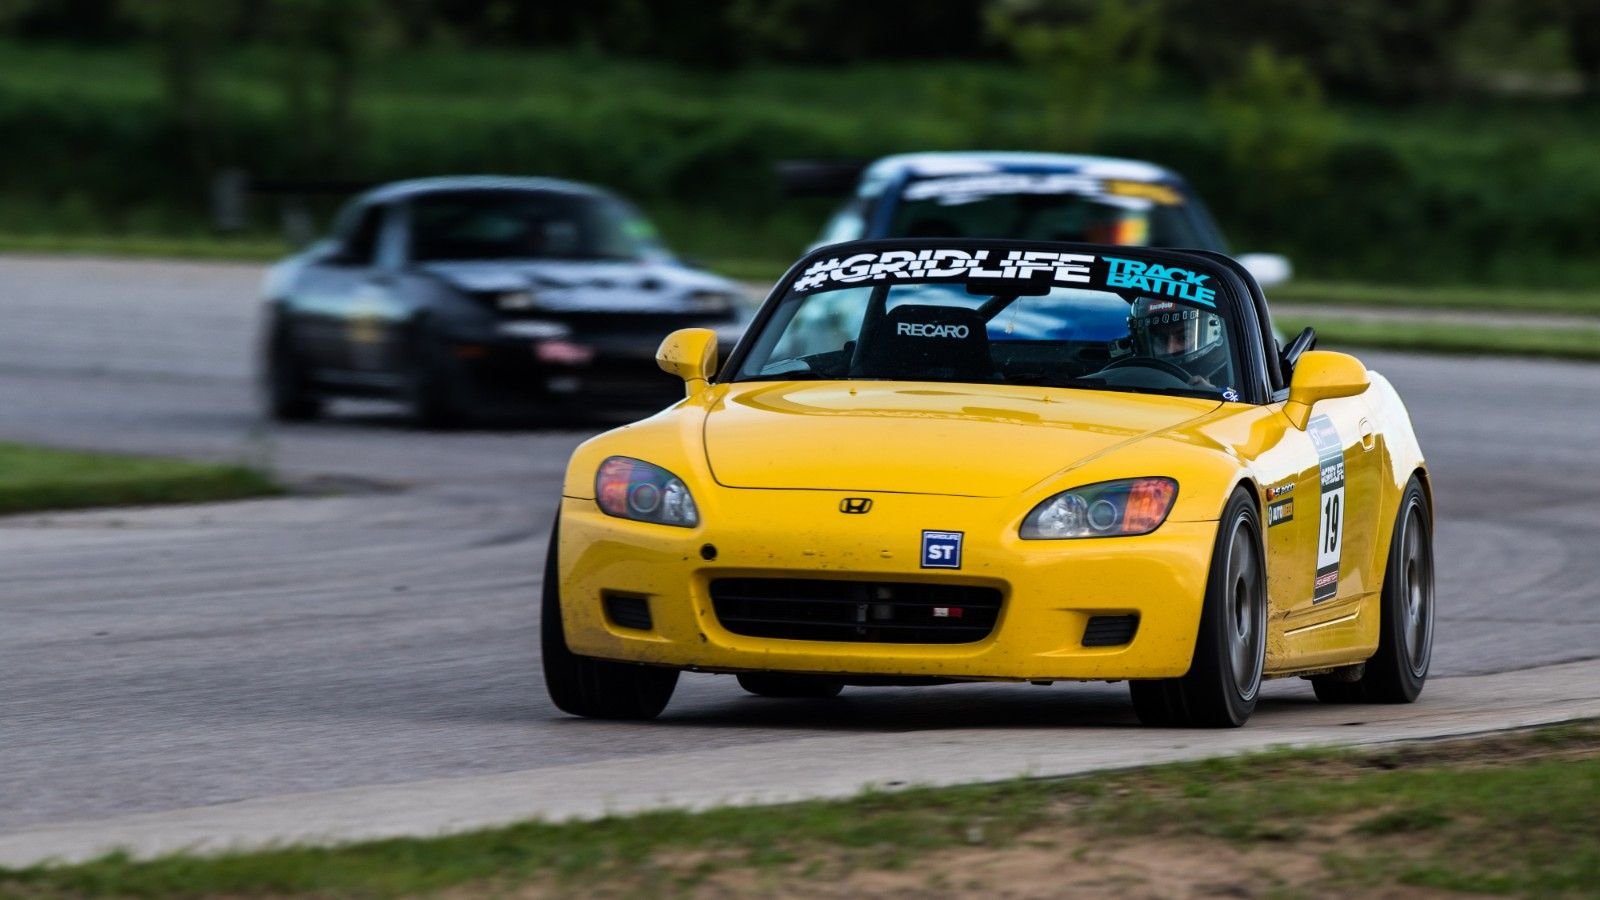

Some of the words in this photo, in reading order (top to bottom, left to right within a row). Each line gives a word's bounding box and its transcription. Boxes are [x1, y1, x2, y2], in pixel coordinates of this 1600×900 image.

[794, 250, 1095, 291] #GRIDLIFE
[1101, 256, 1211, 287] TRACK
[1106, 272, 1217, 308] BATTLE
[897, 322, 970, 339] RECARO
[1323, 493, 1340, 554] 19
[928, 544, 955, 560] ST
